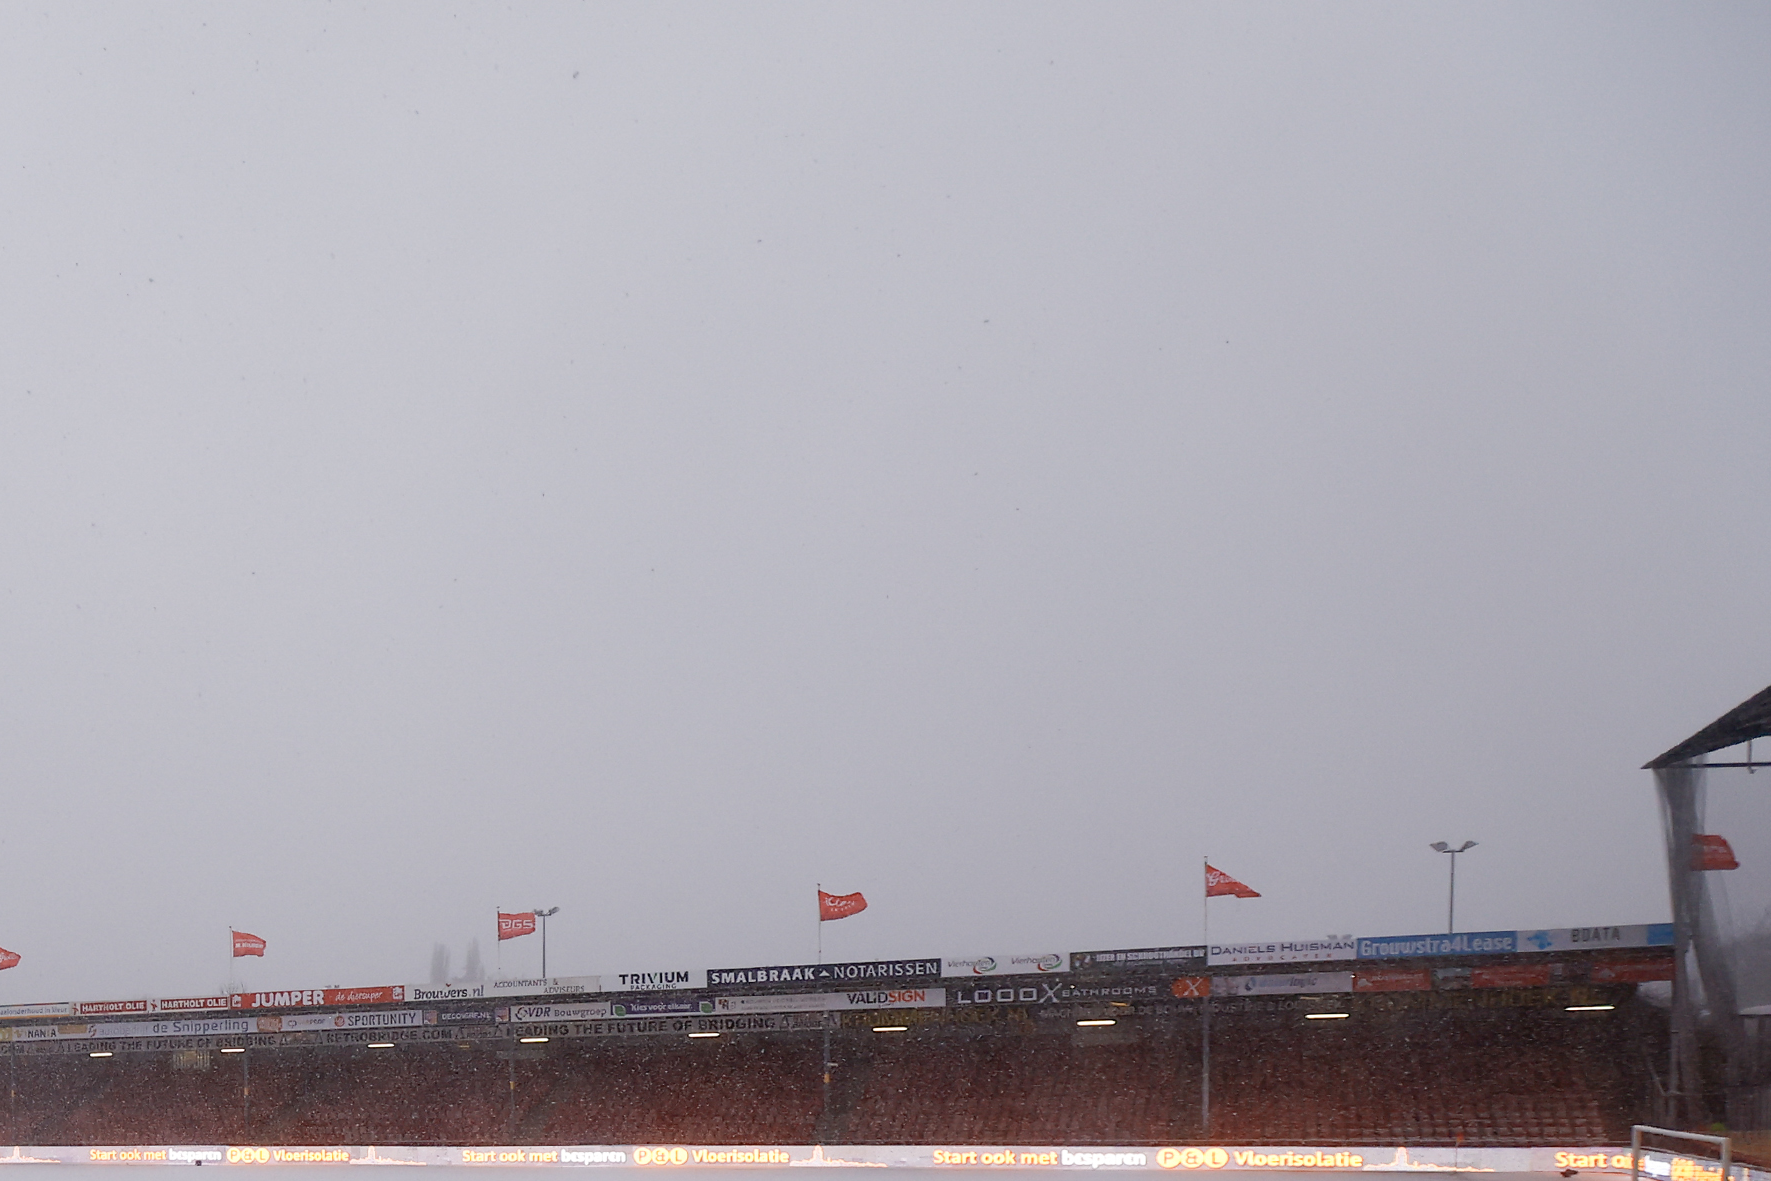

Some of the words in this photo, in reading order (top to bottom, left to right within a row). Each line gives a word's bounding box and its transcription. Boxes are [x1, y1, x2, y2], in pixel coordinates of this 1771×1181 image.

[1211, 944, 1276, 956] DANIELS
[1281, 941, 1355, 953] HUISMAN
[1360, 934, 1513, 957] Grouwstra4Lease
[619, 971, 689, 985] TRIVIUM
[711, 968, 815, 984] SMALBRAAK
[834, 962, 937, 979] NOTARISSEN
[161, 998, 206, 1008] HARTHOLT
[207, 997, 227, 1006] OLIE
[251, 990, 325, 1007] JUMPER
[82, 1003, 124, 1012] HARTHOLT
[125, 1002, 145, 1010] OLIE
[528, 1006, 551, 1017] VDR
[554, 1008, 607, 1018] Bouwgroep
[152, 1023, 169, 1033] de
[173, 1020, 249, 1034] Snipperling
[348, 1012, 417, 1027] SPORTUNITY
[574, 1023, 604, 1035] THE
[607, 1021, 668, 1034] FUTURE
[672, 1019, 692, 1031] OF
[698, 1017, 775, 1031] BRIDGING
[90, 1149, 118, 1161] Start
[119, 1149, 143, 1161] ook
[143, 1149, 167, 1161] met
[272, 1149, 350, 1162] Vloerisolatie
[462, 1149, 497, 1164] Start
[499, 1149, 527, 1164] ook
[528, 1150, 558, 1164] met
[691, 1149, 790, 1164] Vloerisolatie
[932, 1149, 978, 1166] Start
[979, 1149, 1017, 1166] ook
[1019, 1150, 1059, 1166] met
[1232, 1149, 1365, 1168] Vloerisolatie
[1554, 1151, 1608, 1169] Start
